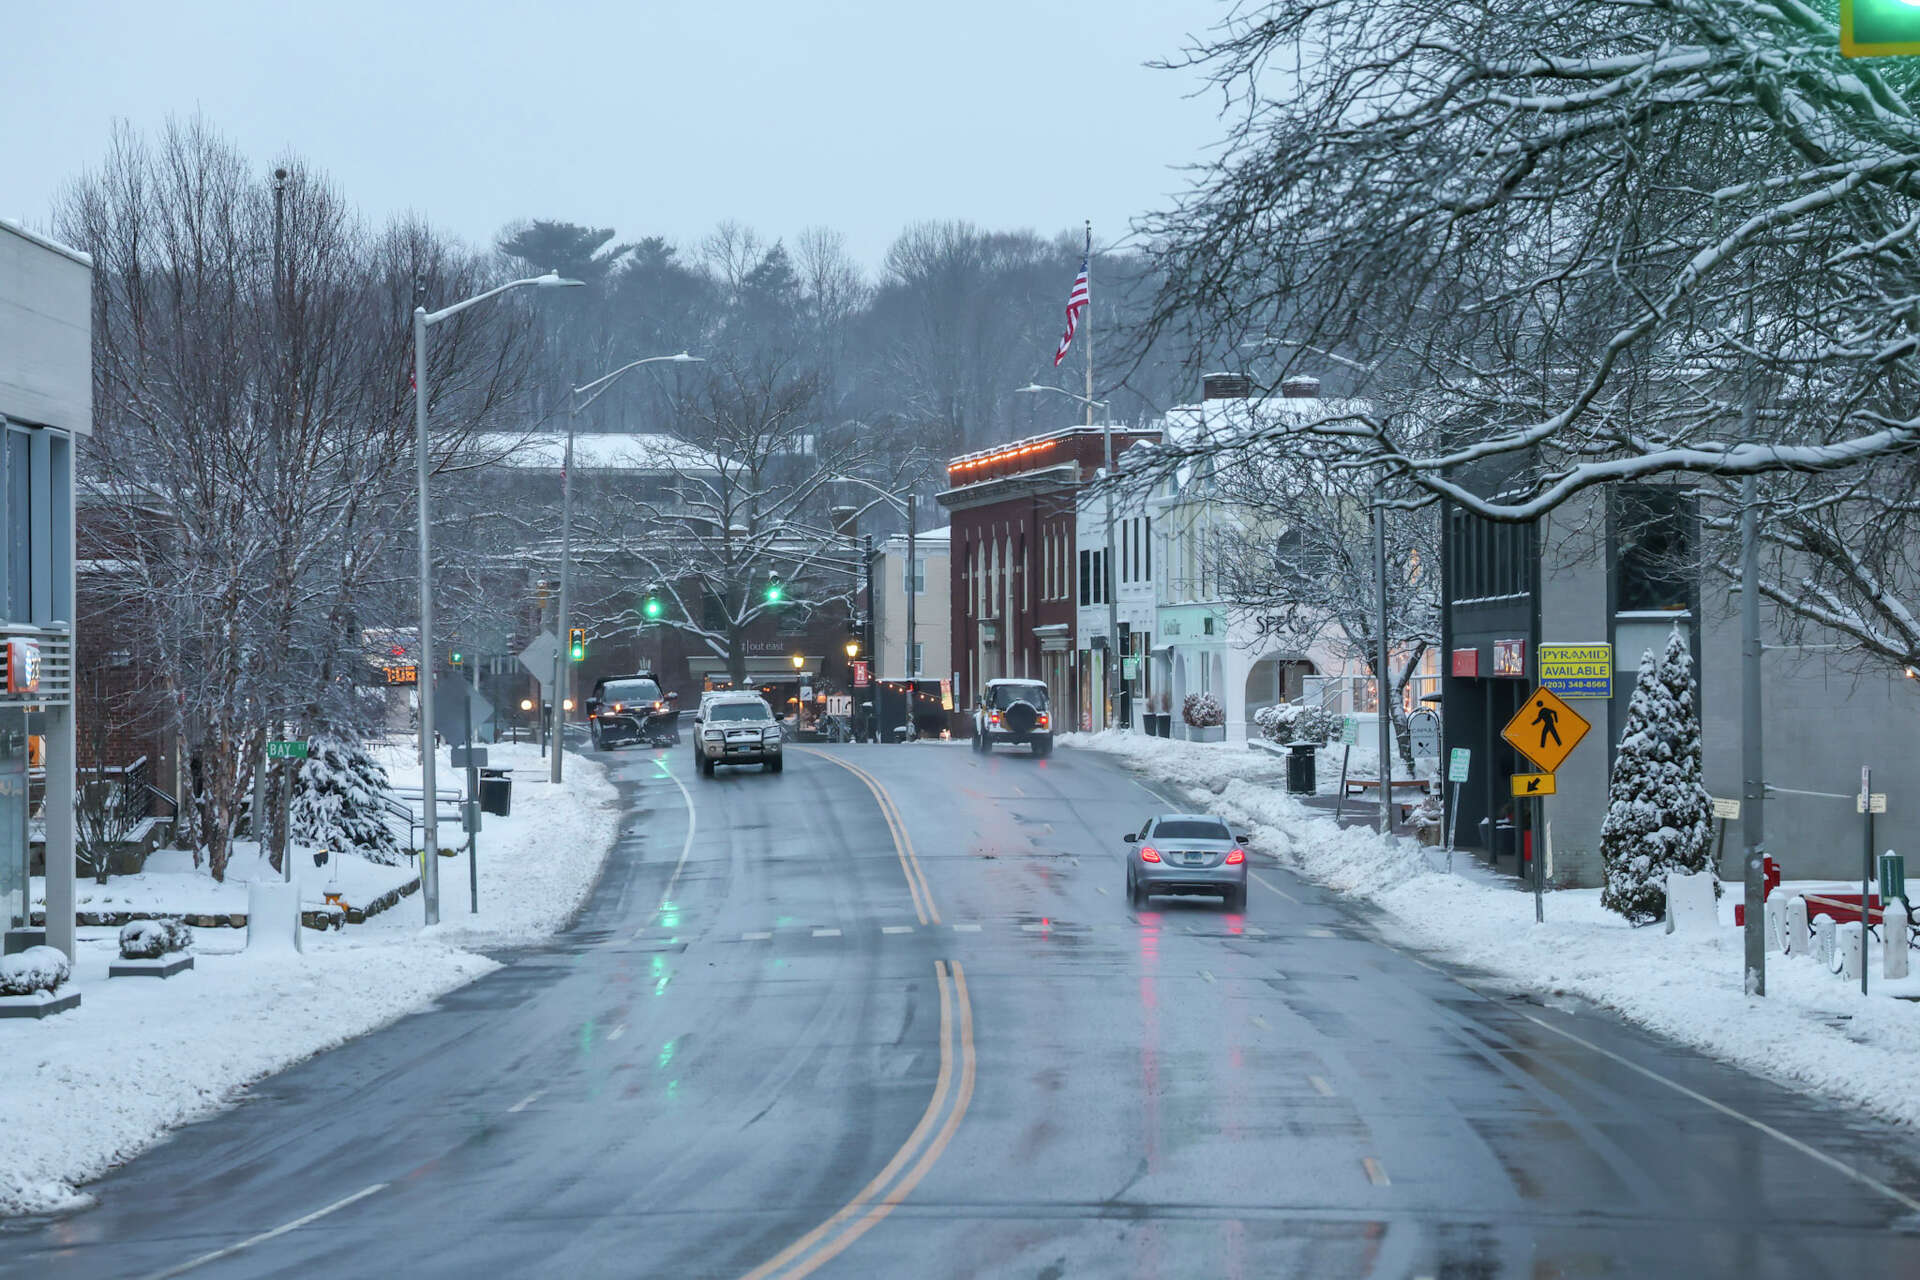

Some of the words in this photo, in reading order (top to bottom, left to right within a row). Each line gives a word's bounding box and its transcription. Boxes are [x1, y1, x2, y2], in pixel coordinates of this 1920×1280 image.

[1543, 650, 1608, 660] PYRAMID
[1545, 666, 1607, 676] AVAILABLE
[270, 743, 290, 756] BAY
